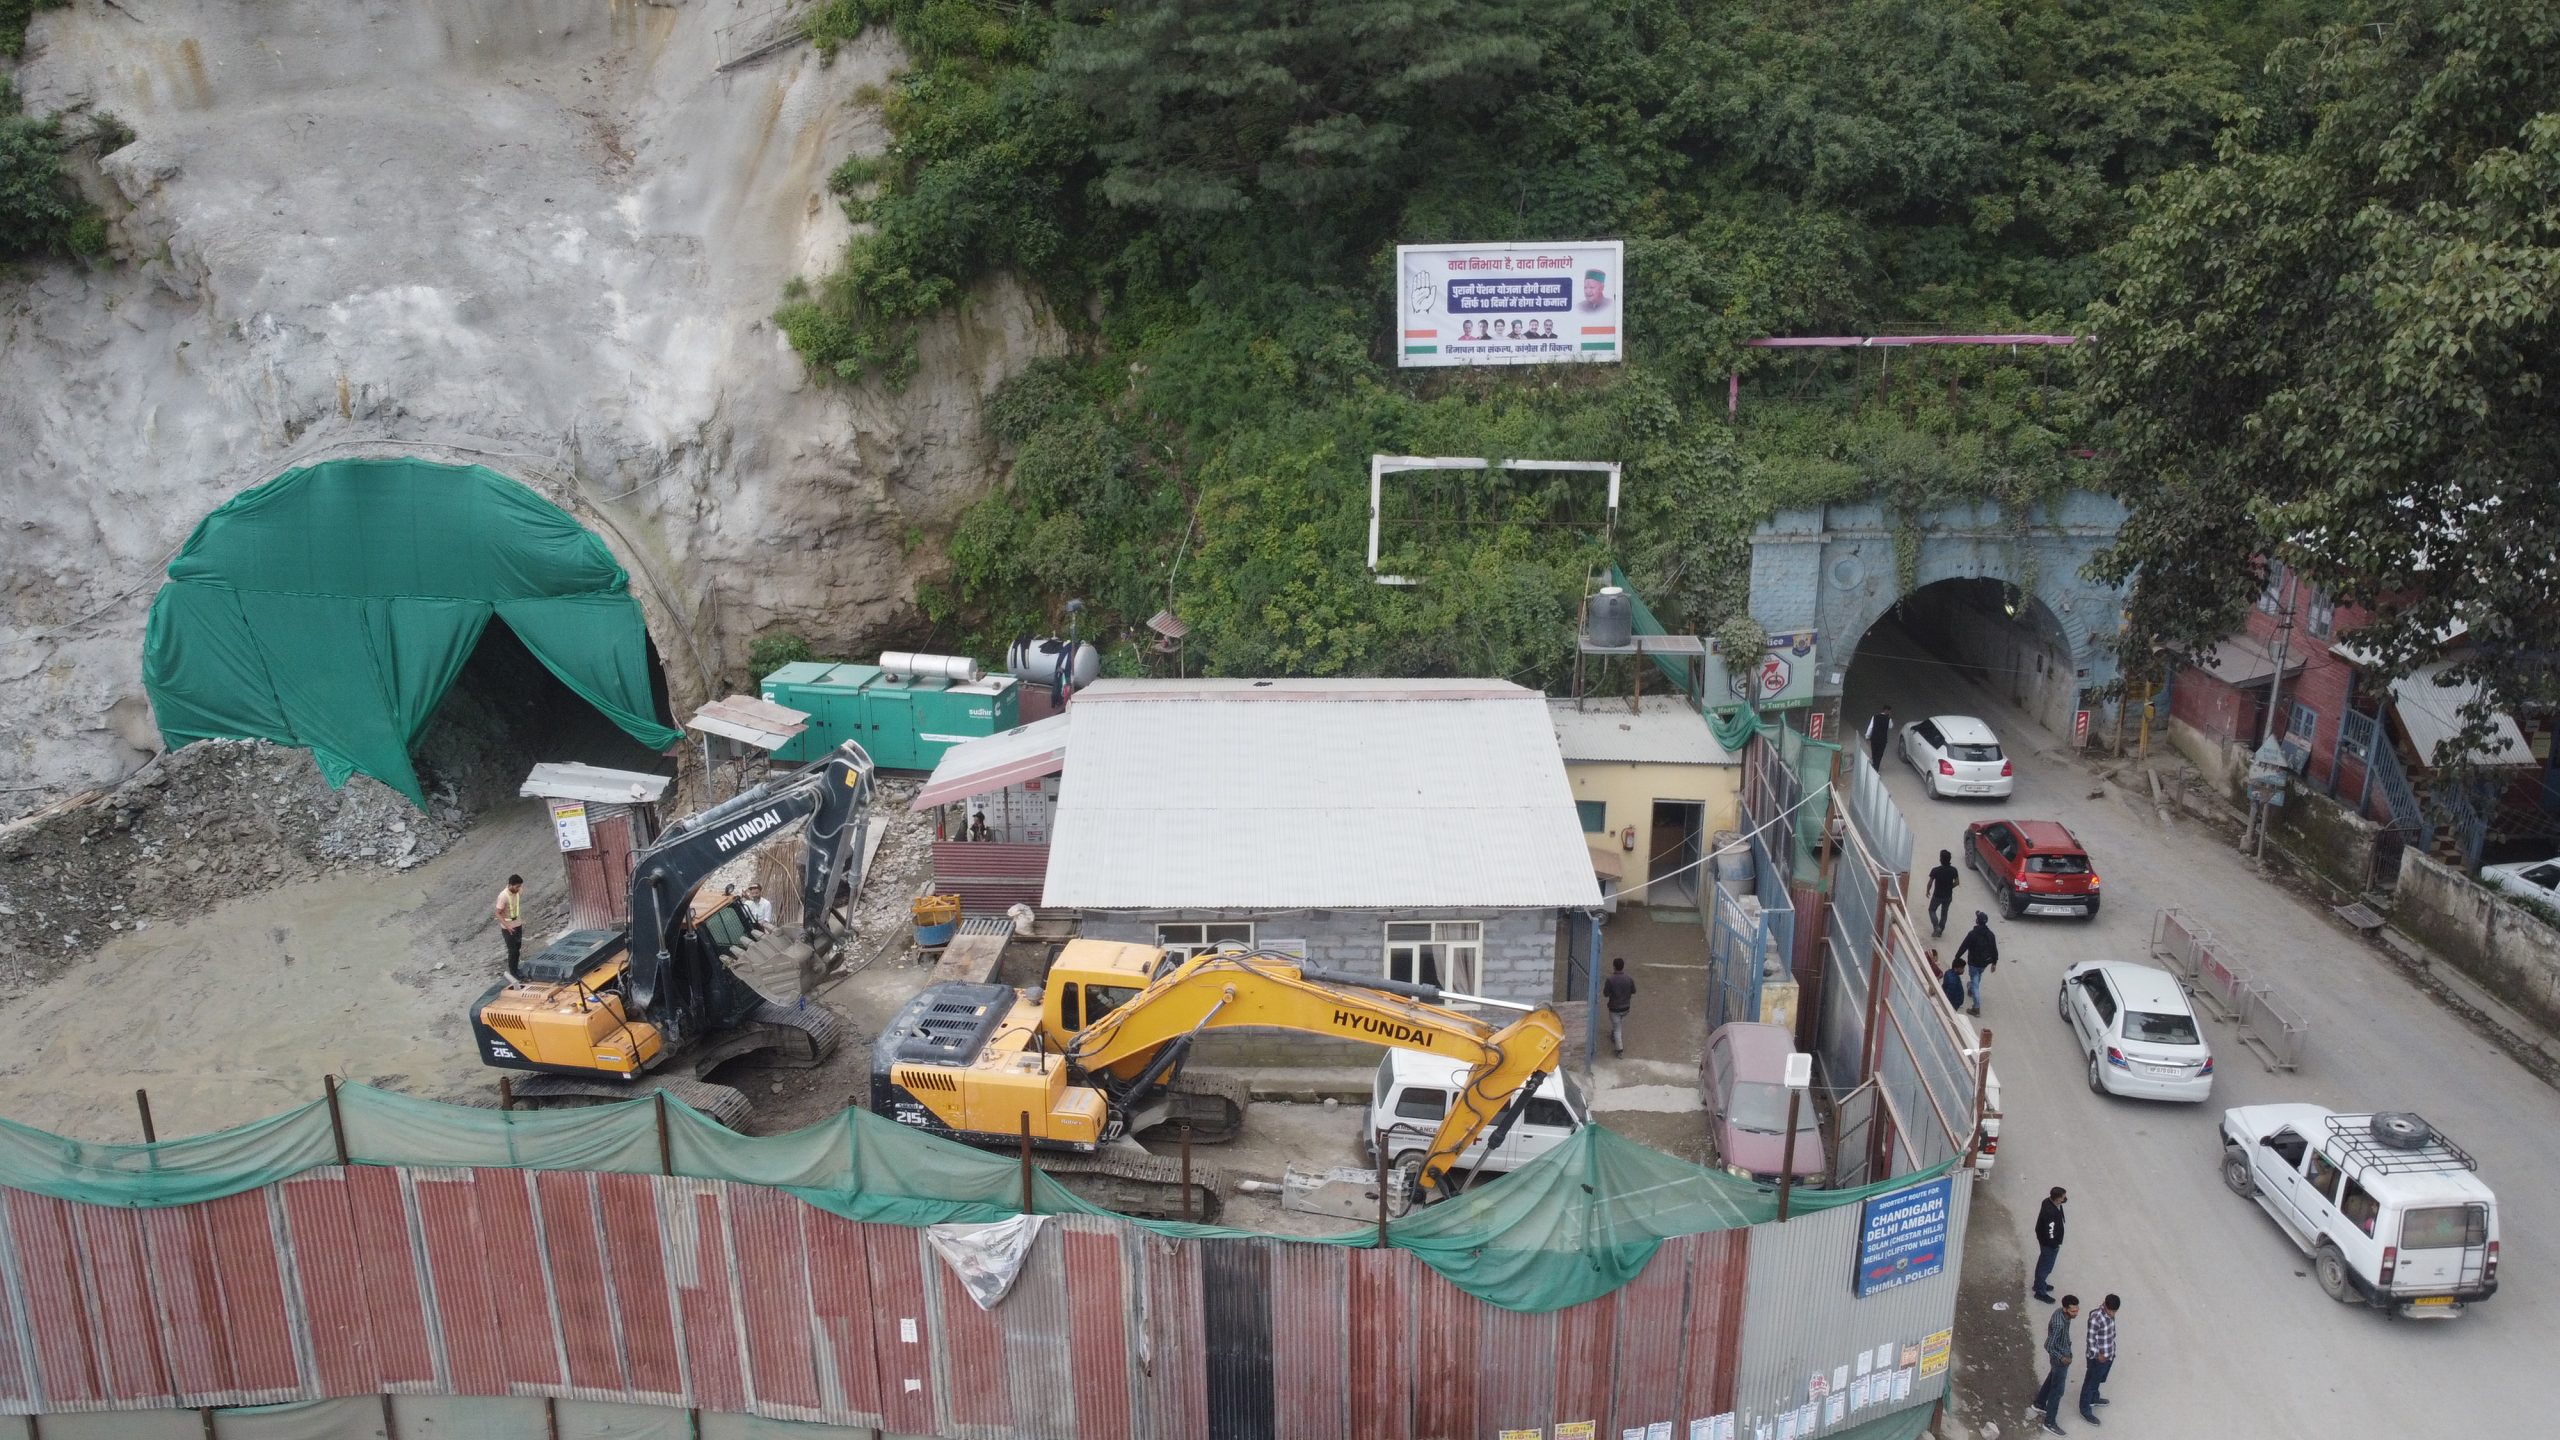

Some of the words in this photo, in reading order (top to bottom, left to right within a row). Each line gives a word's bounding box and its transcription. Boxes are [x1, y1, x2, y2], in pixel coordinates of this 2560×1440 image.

[1448, 260, 1466, 270] वादा
[1468, 257, 1502, 270] निभाया
[1516, 258, 1534, 270] वादा
[1536, 256, 1573, 270] निभाएंगे
[1452, 283, 1474, 298] पुरानी
[1476, 284, 1496, 294] पेंशन
[1497, 282, 1522, 294] योजना
[1523, 282, 1538, 294] होगी
[1540, 284, 1560, 294] बहाल
[1461, 296, 1478, 308] सिर्फ
[1480, 299, 1489, 308] 10
[1491, 296, 1508, 308] दिनों
[1509, 296, 1517, 308] में
[1519, 297, 1534, 307] होगा
[1536, 296, 1542, 307] ये
[1543, 297, 1568, 307] कमाल
[715, 809, 782, 852] HYUNDAI
[1333, 1010, 1433, 1047] HYUNDAI
[1872, 1198, 1943, 1228] CHANDIGARH
[1879, 1196, 1908, 1210] SHORTEST
[1909, 1190, 1927, 1201] ROUTE
[1928, 1187, 1939, 1196] FOR
[1867, 1222, 1898, 1242] DELHI
[1901, 1209, 1945, 1231] AMBALA
[1867, 1240, 1888, 1253] SOLAN
[1922, 1223, 1944, 1235] HILLS)
[1864, 1252, 1884, 1264] MEHLI
[1919, 1233, 1945, 1247] VALLEY)
[1865, 1278, 1902, 1296] SHIMLA
[1905, 1265, 1940, 1283] POLICE
